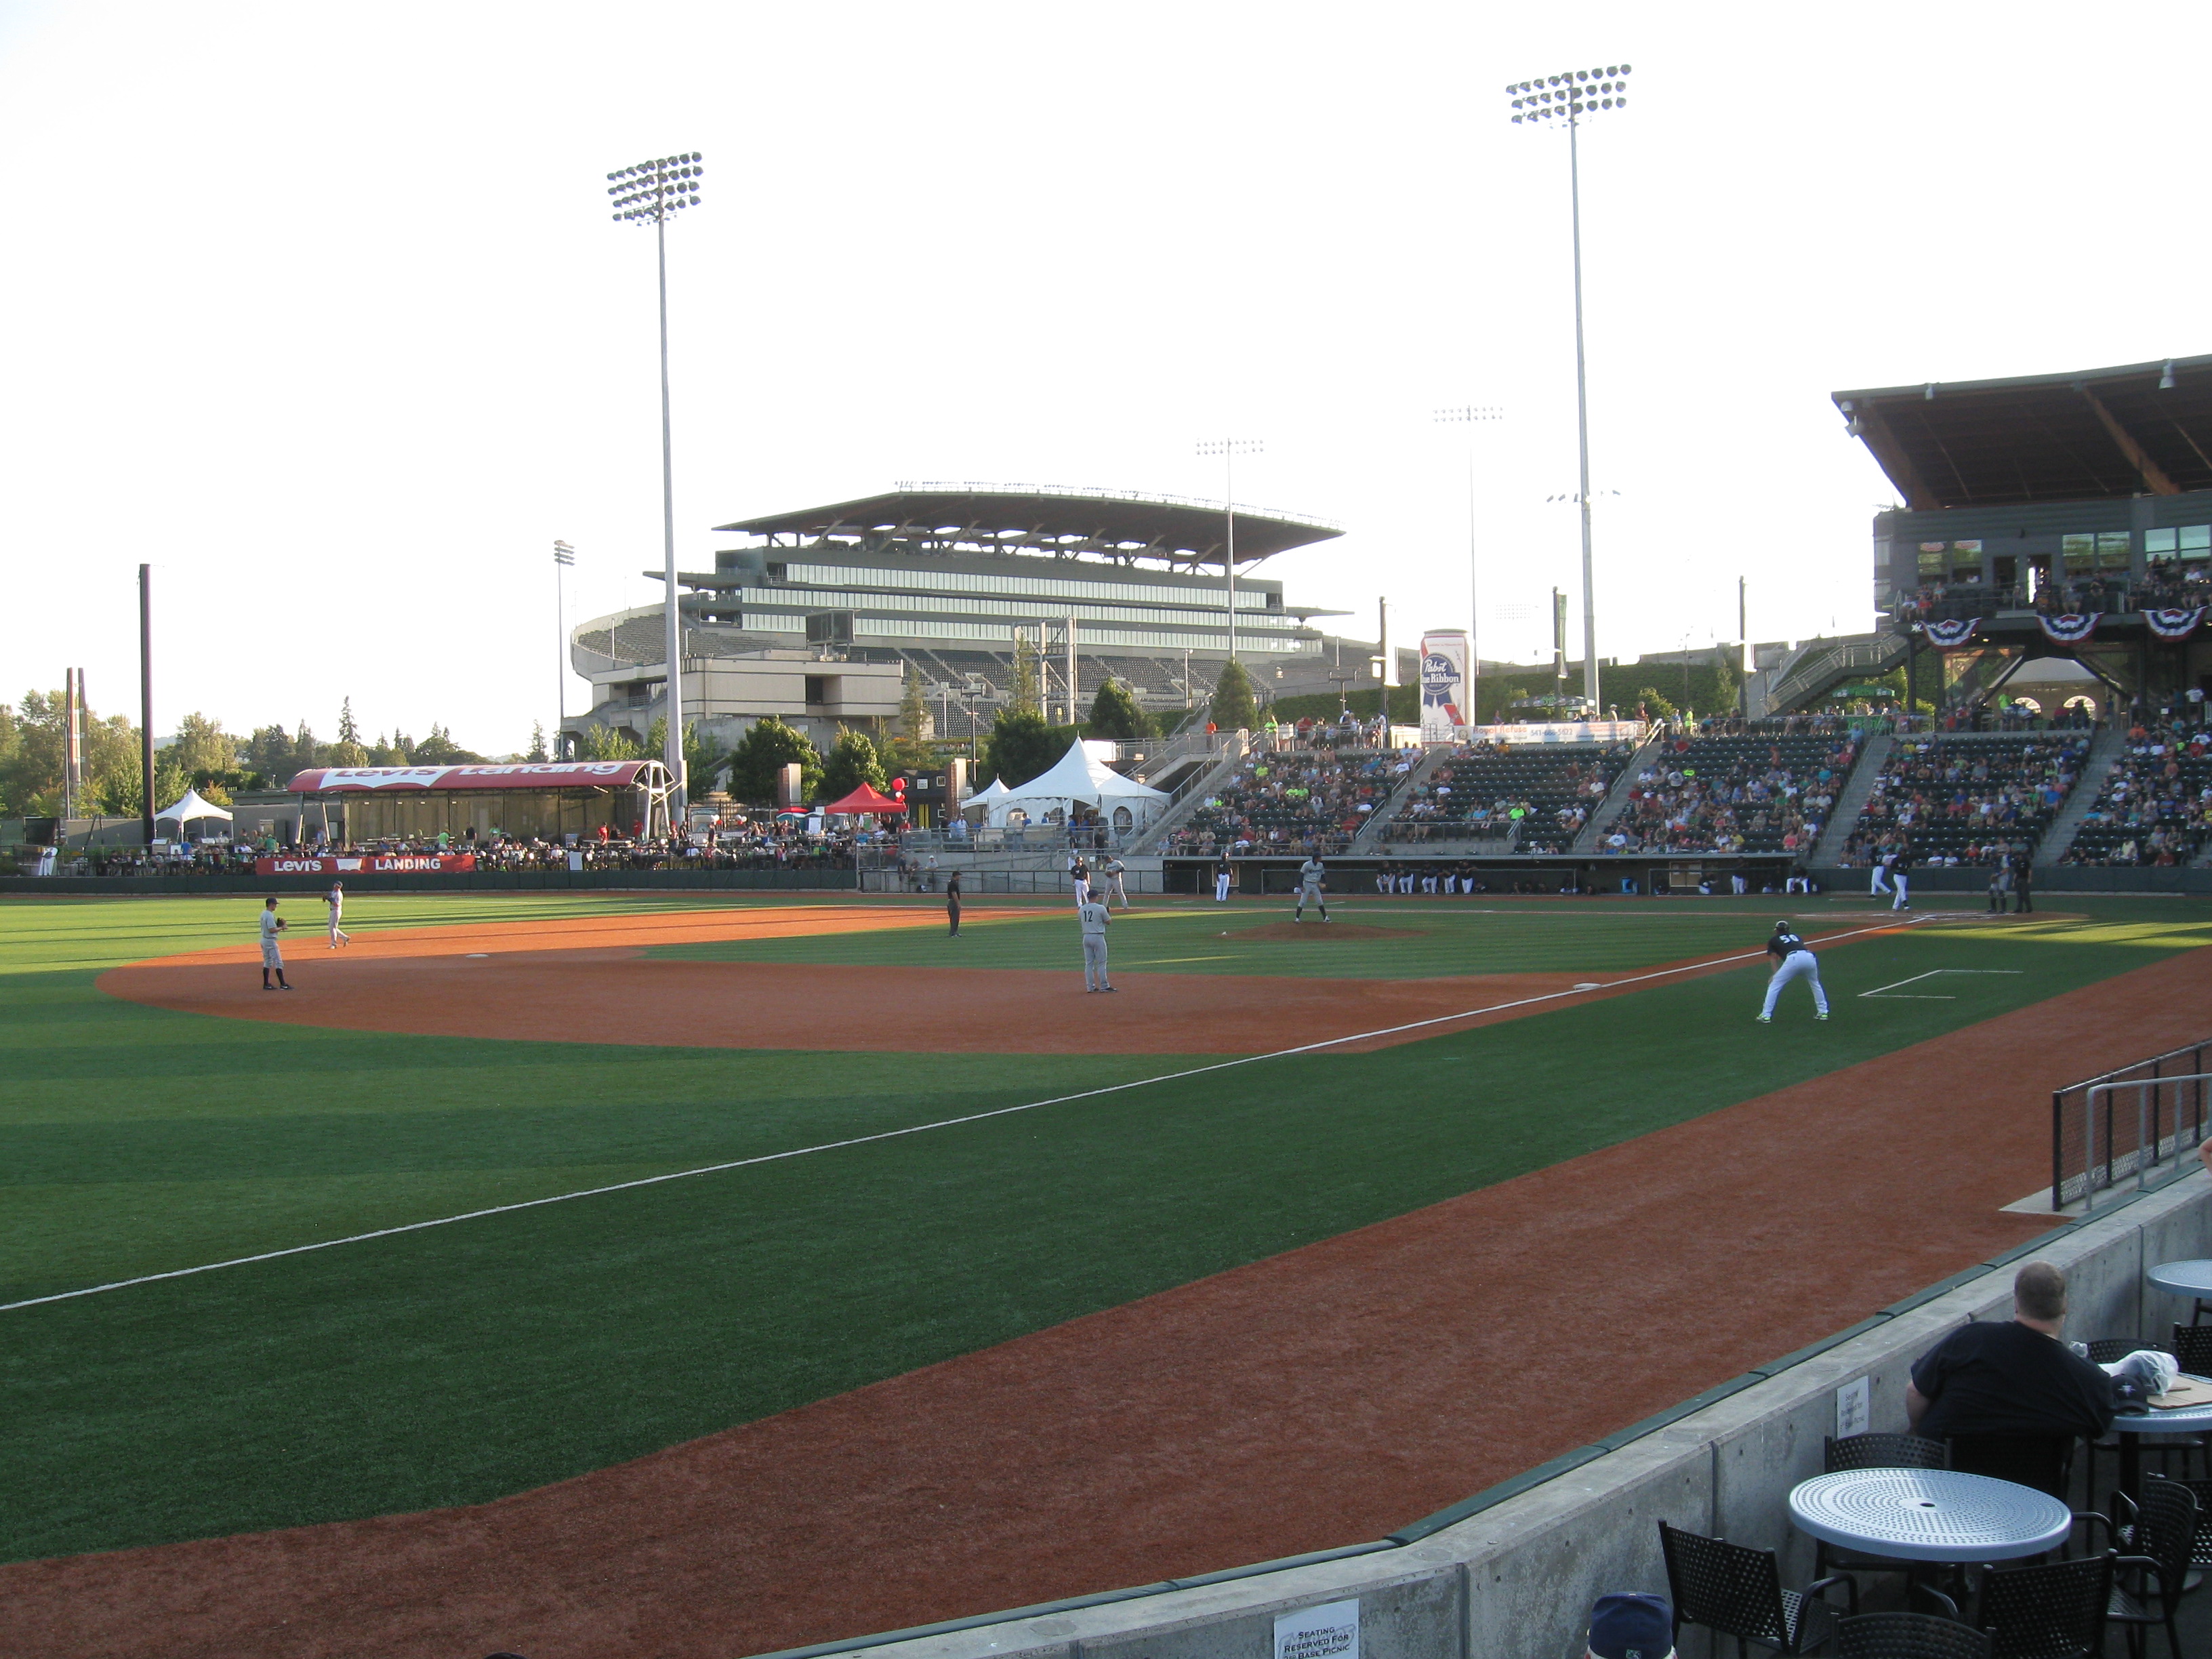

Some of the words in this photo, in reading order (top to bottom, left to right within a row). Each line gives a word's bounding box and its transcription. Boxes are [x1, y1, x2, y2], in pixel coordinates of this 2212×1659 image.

[1424, 659, 1448, 673] Pabst
[1431, 673, 1460, 683] Ribbon
[375, 858, 441, 870] LANDING
[1084, 911, 1093, 922] 12
[1779, 934, 1799, 944] 50
[1298, 1626, 1335, 1639] SEATING
[1284, 1638, 1330, 1653] RESERVED
[1332, 1634, 1349, 1643] FOR
[1298, 1650, 1321, 1659] BASE
[1322, 1644, 1350, 1655] PICNIC
